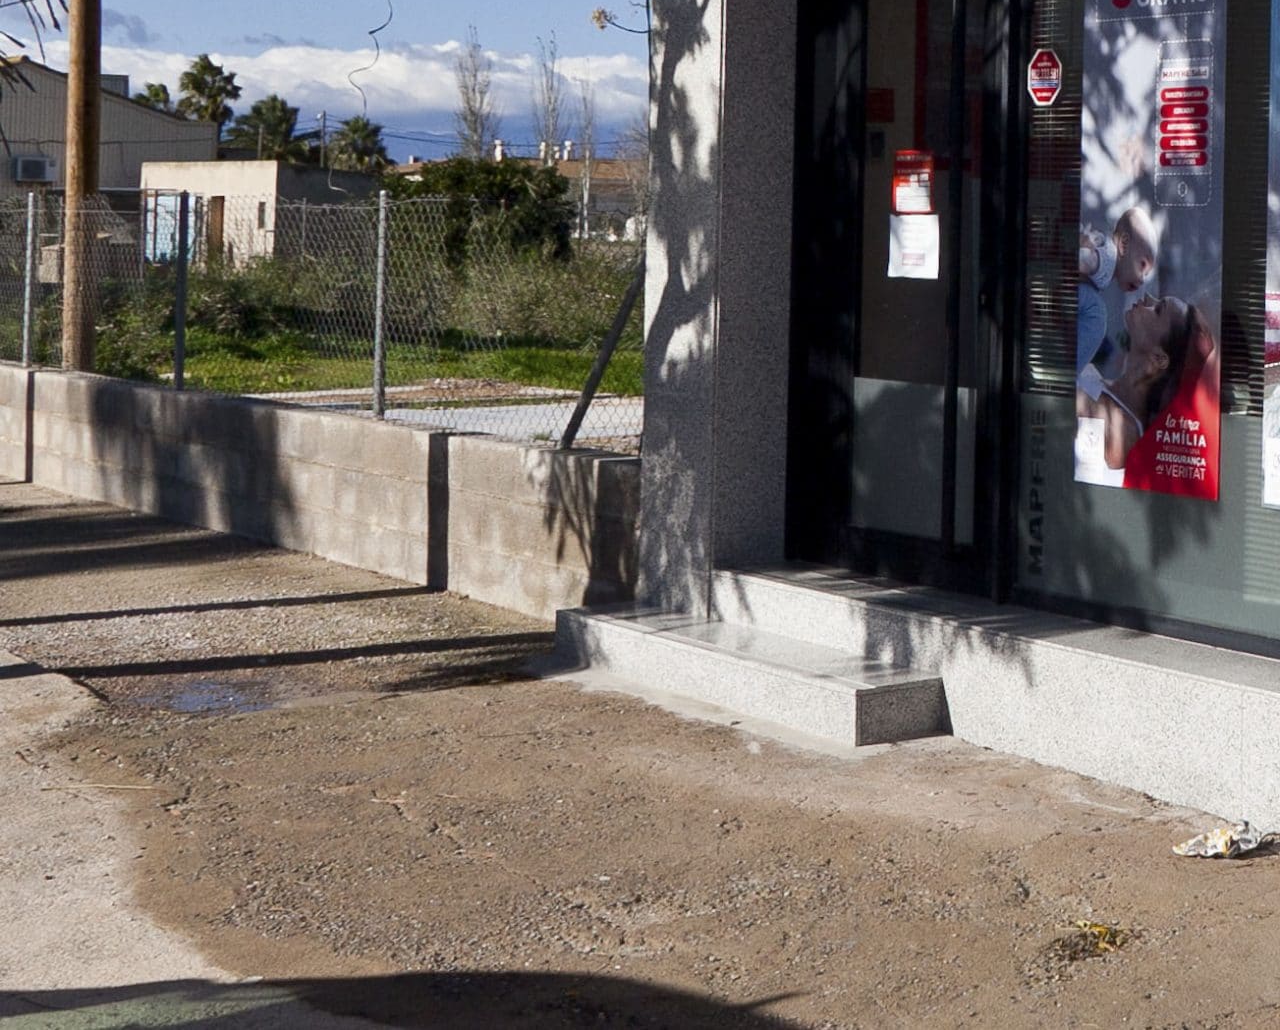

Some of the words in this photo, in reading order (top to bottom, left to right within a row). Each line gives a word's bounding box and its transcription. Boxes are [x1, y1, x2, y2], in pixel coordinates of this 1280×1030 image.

[1165, 413, 1176, 428] la
[1156, 430, 1207, 448] FAMÍLIA
[1155, 453, 1207, 467] ASSEGURANÇA
[1165, 464, 1207, 481] VERITAT
